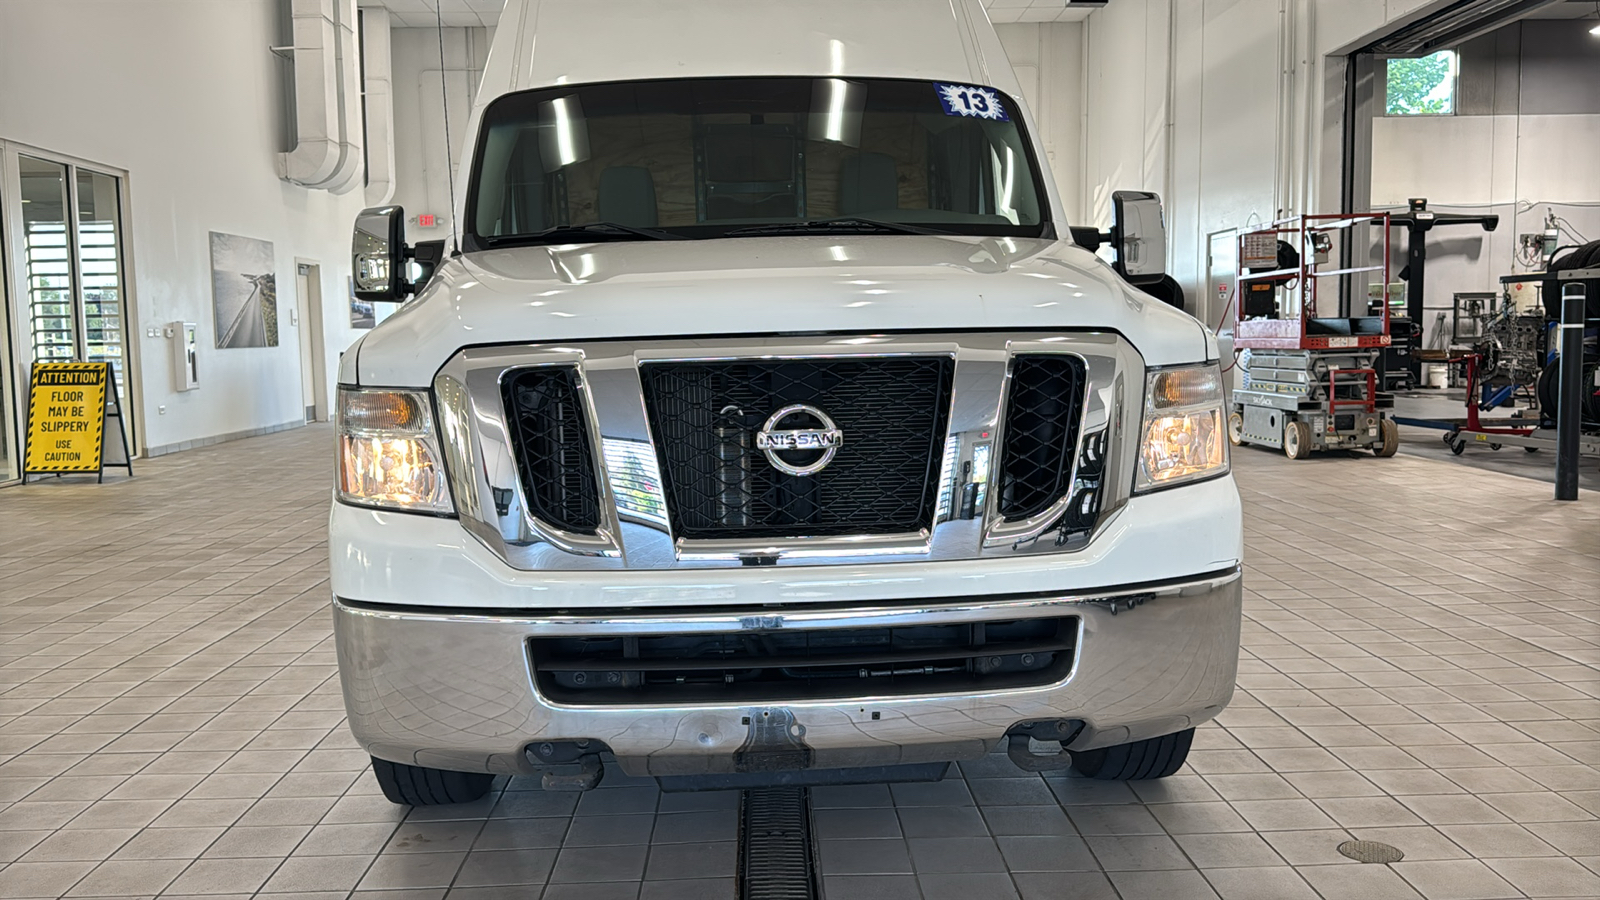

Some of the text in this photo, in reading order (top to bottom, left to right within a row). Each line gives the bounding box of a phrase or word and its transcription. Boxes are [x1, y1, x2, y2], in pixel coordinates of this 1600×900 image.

[957, 90, 989, 113] 13
[419, 214, 434, 227] EXIT
[40, 372, 97, 384] ATTENTION
[51, 391, 84, 402] FLOOR
[48, 406, 85, 417] MAY BE
[40, 421, 90, 432] SLIPPERY
[55, 440, 72, 449] USE
[766, 433, 835, 447] NISSAN
[44, 452, 81, 462] CAUTION
